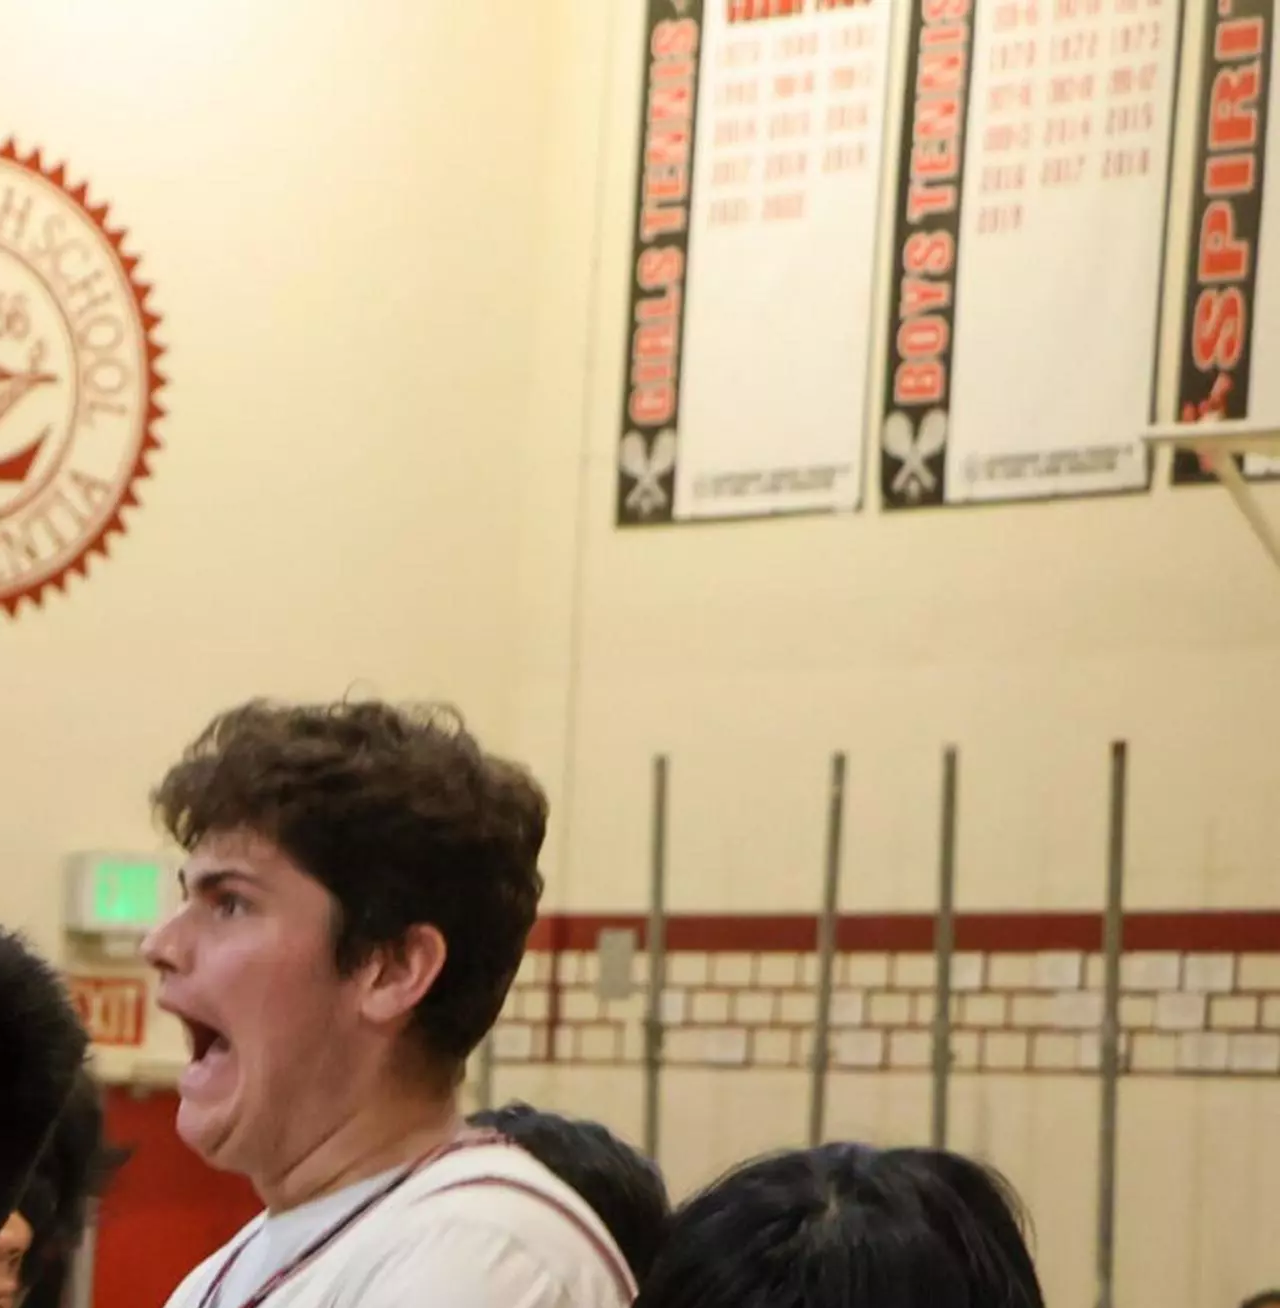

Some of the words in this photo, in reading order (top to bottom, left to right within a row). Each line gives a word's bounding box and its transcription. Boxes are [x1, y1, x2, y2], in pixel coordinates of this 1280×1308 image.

[640, 18, 699, 243] TENNIS
[1192, 0, 1264, 372] SPIRI
[30, 213, 130, 428] SCHOOL
[629, 246, 684, 426] GIRLS
[894, 230, 954, 402] BOYS
